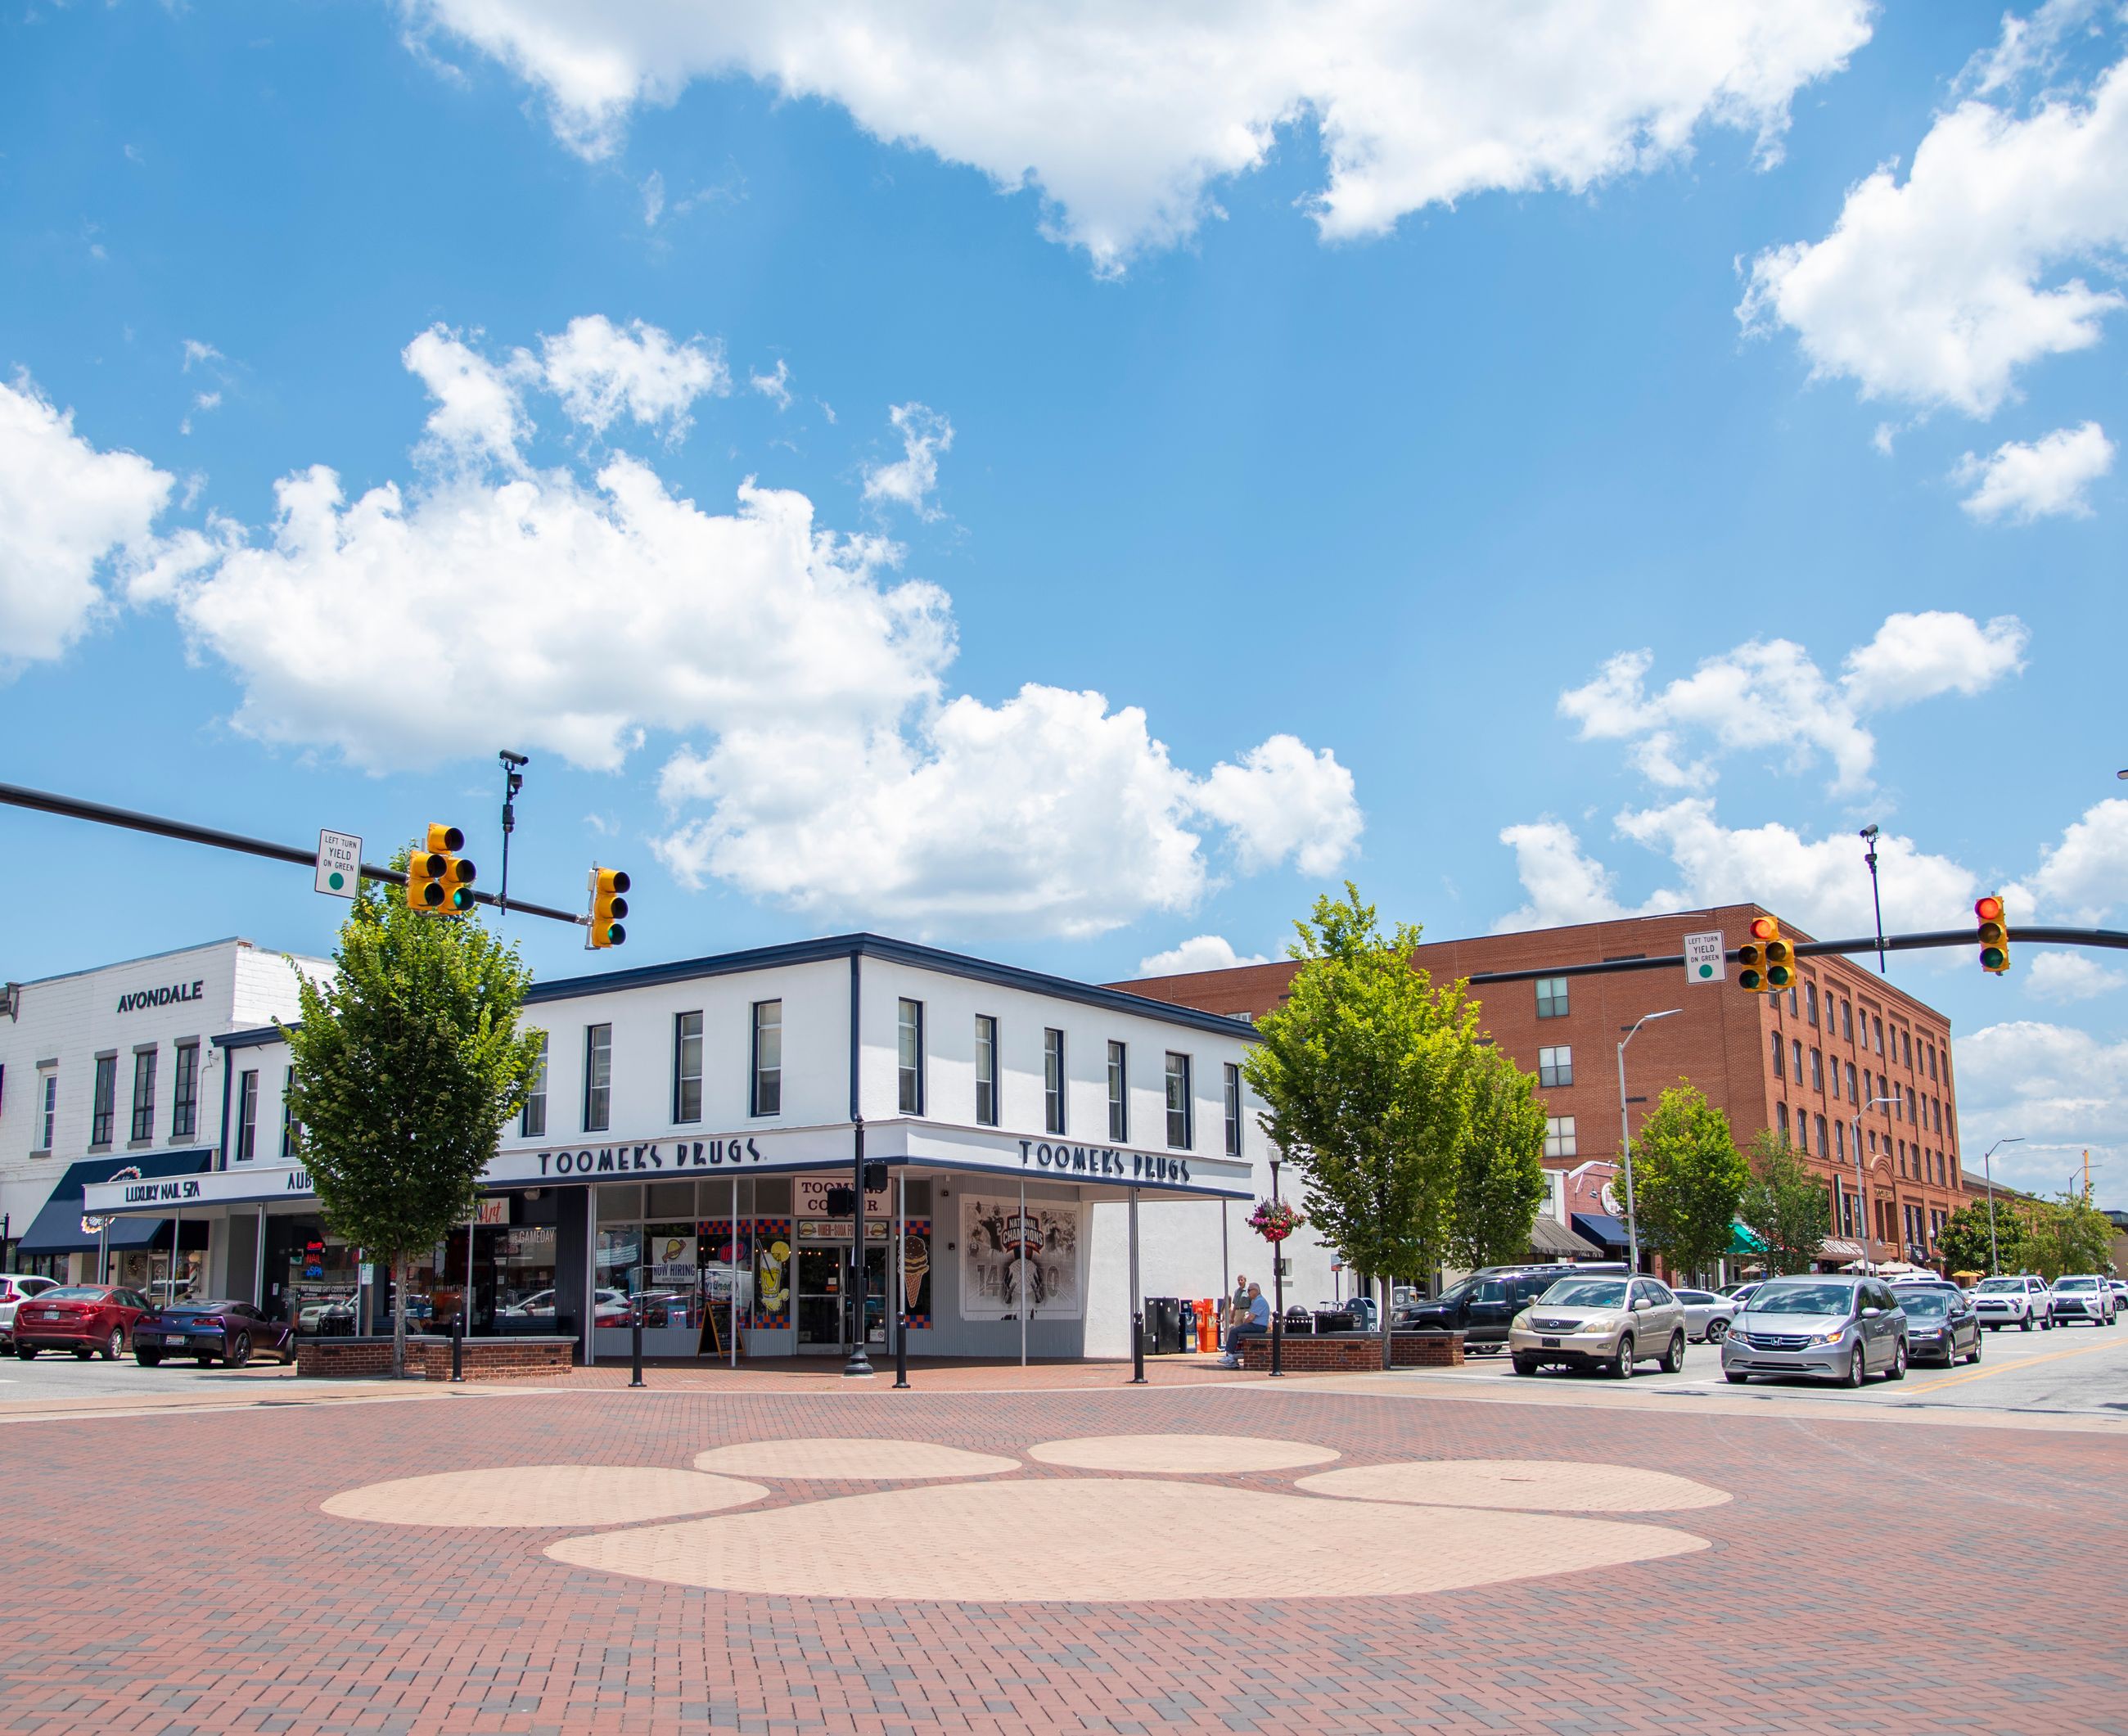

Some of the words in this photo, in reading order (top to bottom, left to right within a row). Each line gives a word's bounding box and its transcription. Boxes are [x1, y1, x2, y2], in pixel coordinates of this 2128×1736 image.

[325, 836, 339, 845] LEFT
[340, 839, 357, 849] TURN
[329, 847, 351, 860] YIELD
[323, 859, 332, 868] ON
[335, 861, 354, 872] GREEN
[1693, 945, 1715, 954] YIELD
[117, 980, 203, 1013] AVONDALE
[538, 1143, 662, 1175] TOOMER'S
[677, 1138, 760, 1166] DRUGS
[1019, 1140, 1125, 1175] TOOMER'S
[1134, 1153, 1190, 1182] DRUGS
[125, 1184, 160, 1202] LUXURY
[160, 1182, 181, 1200] NAIL
[183, 1180, 201, 1198] SPA
[1009, 1218, 1037, 1230] NATNAL
[653, 1264, 669, 1276] NOW
[670, 1264, 695, 1277] HIRING
